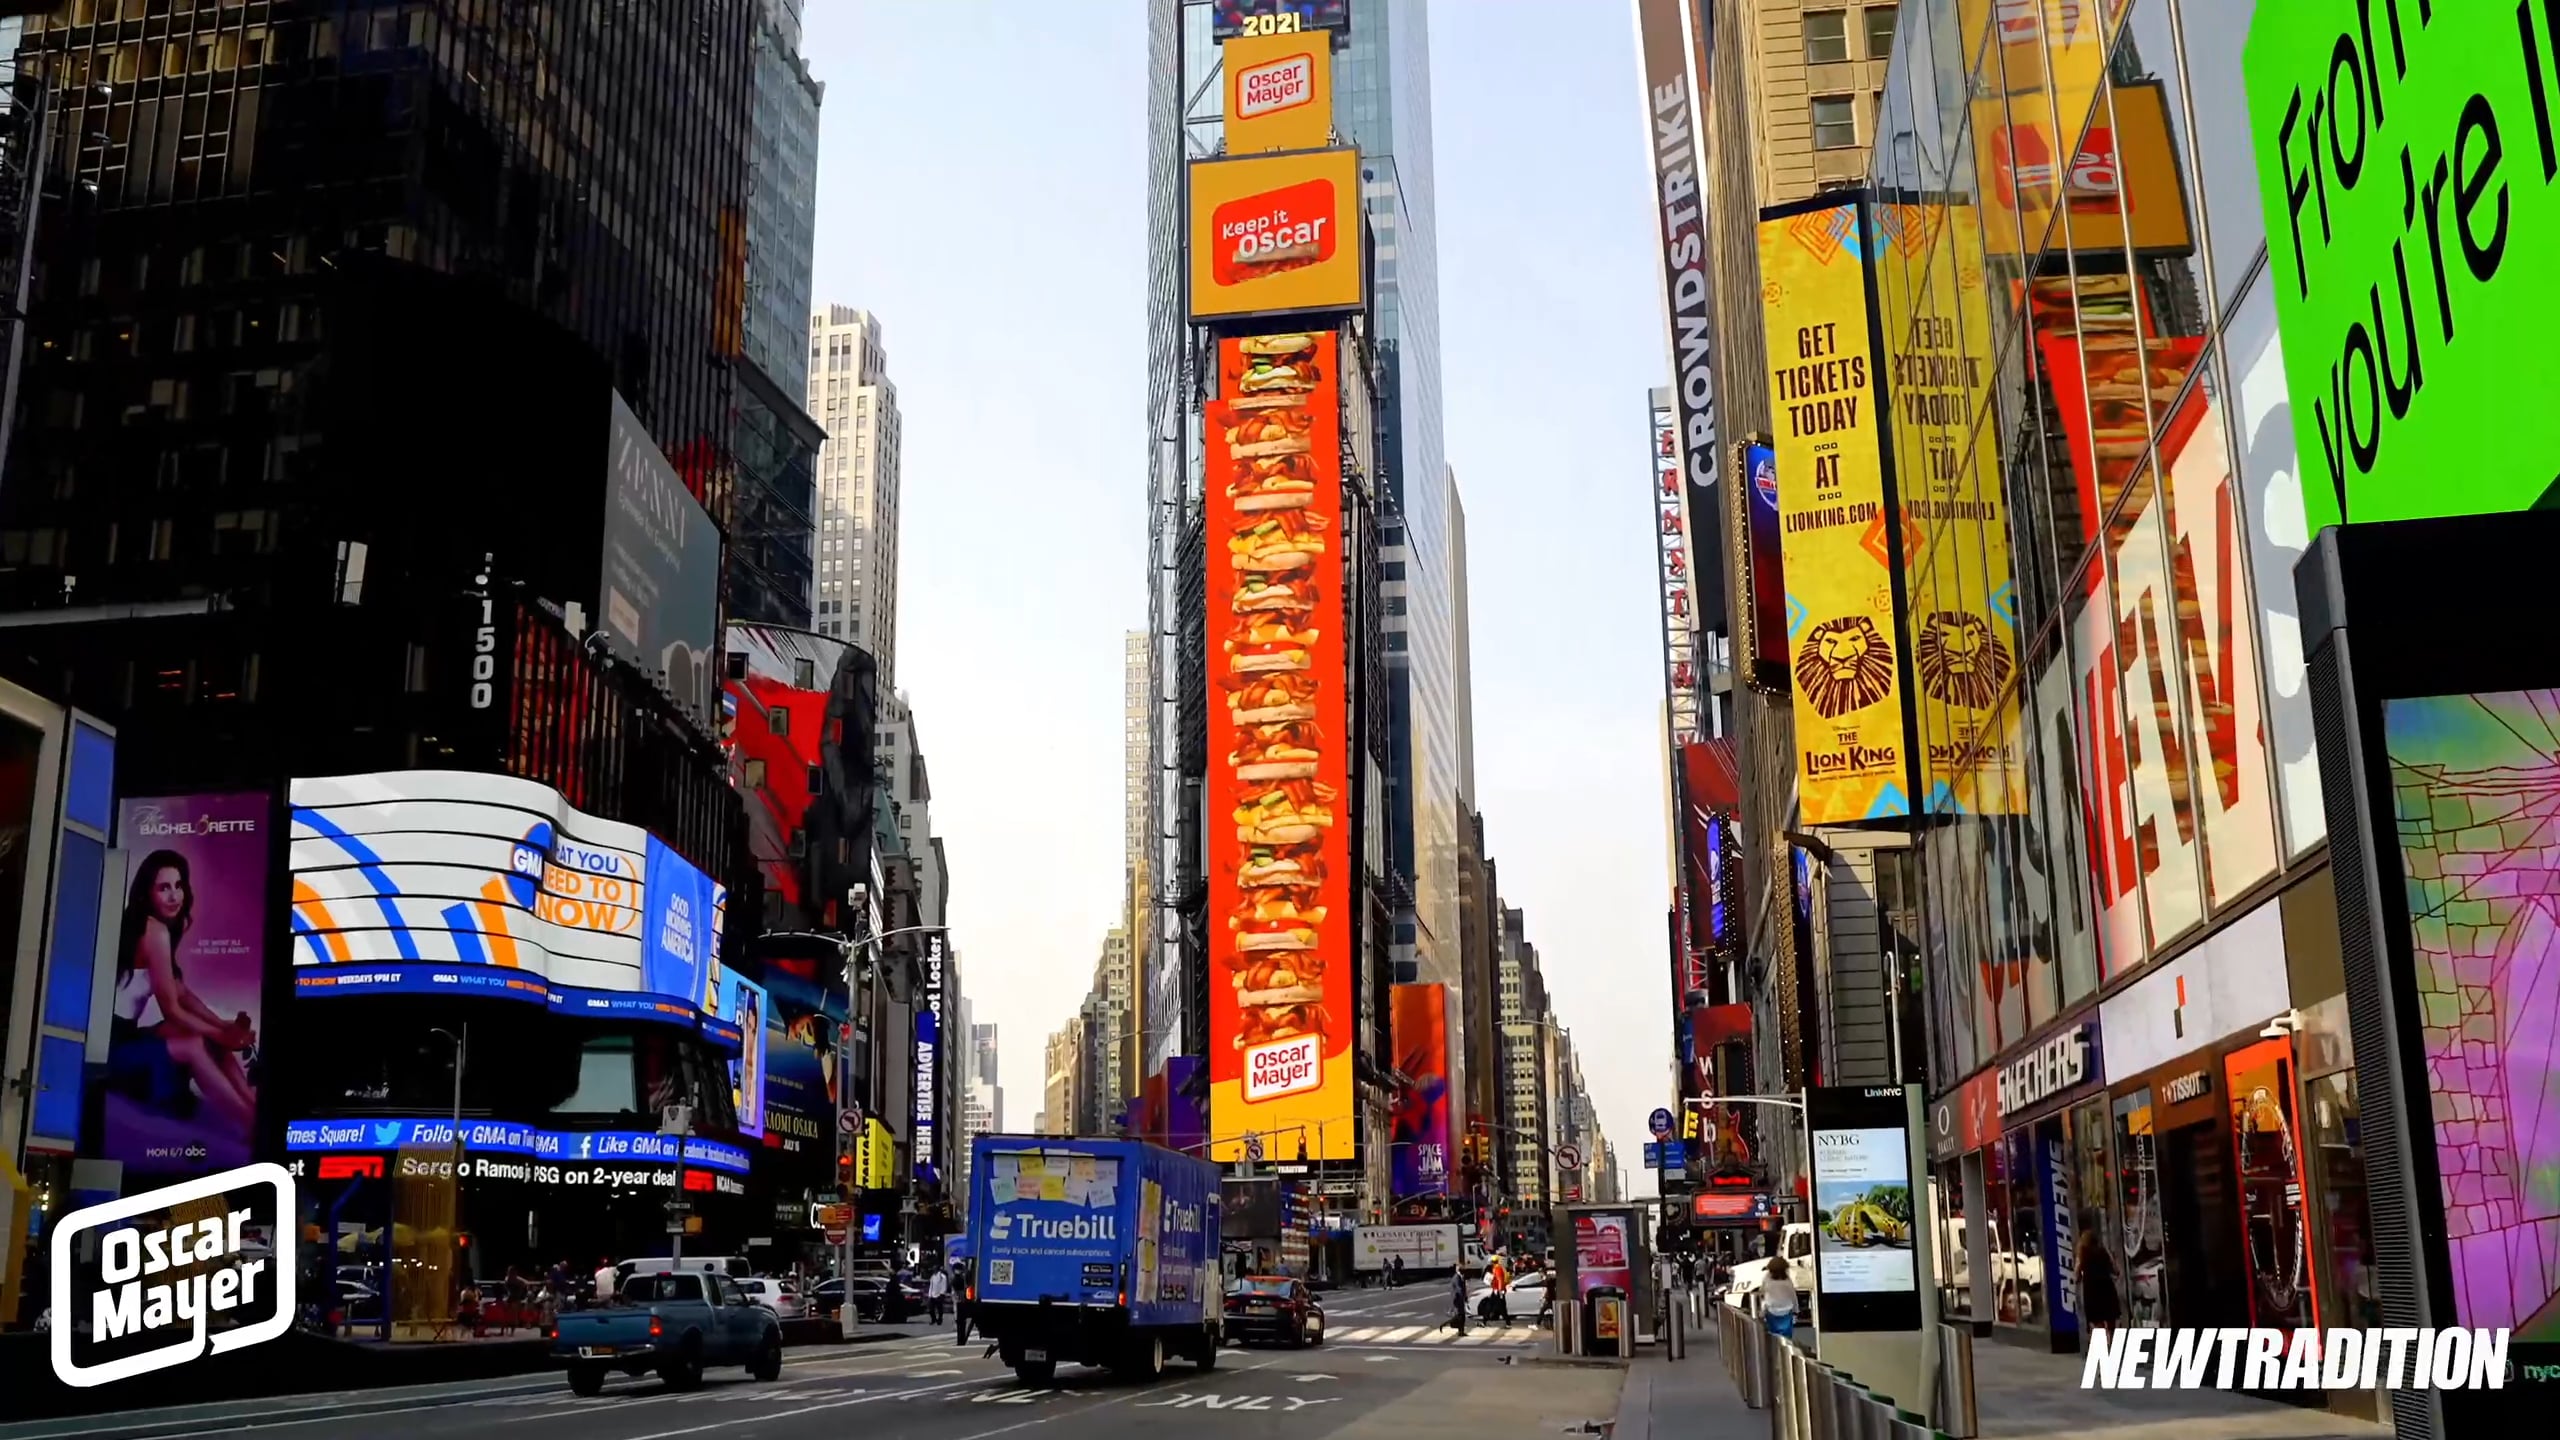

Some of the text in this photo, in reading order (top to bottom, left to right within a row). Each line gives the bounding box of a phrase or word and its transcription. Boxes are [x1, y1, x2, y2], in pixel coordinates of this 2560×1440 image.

[1242, 12, 1301, 37] 2021
[1248, 63, 1302, 91] Oscar
[1246, 78, 1304, 107] Mayer
[1222, 209, 1290, 241] Keep it
[1653, 73, 1718, 488] CROWDSTRIKE
[2314, 92, 2509, 525] you're
[1797, 322, 1837, 360] GET
[1775, 356, 1867, 401] TICKETS
[1788, 395, 1859, 438] TODAY
[1815, 453, 1841, 490] AT
[1785, 502, 1878, 534] LIONKING.COM
[470, 599, 496, 709] 1500
[1836, 731, 1858, 744] THE
[1805, 744, 1896, 776] LION KING
[139, 815, 256, 836] BACHELORETTE
[577, 850, 619, 874] YOU
[589, 876, 622, 902] TO
[670, 891, 690, 919] GOOD
[664, 906, 693, 941] MORNING
[660, 927, 695, 967] AMERICA
[926, 936, 943, 990] Locker
[459, 976, 487, 986] WHAT
[488, 977, 506, 988] YOU
[611, 1000, 636, 1009] WHAT
[638, 1001, 656, 1011] YOU
[1254, 1044, 1311, 1070] Oscar
[1996, 1023, 2084, 1119] SKECHERS
[1252, 1061, 1313, 1089] Mayer
[915, 1040, 934, 1165] ADVERTISE HERE
[1864, 1087, 1902, 1098] LinkNYC
[318, 1125, 365, 1147] Square!
[471, 1125, 507, 1145] GMA
[507, 1131, 522, 1145] on
[763, 1109, 819, 1140] NAOMI OSAKA
[146, 1148, 169, 1158] MON
[184, 1145, 208, 1158] abc
[597, 1136, 629, 1154] Like
[631, 1137, 662, 1156] GMA
[1417, 1143, 1443, 1156] SPACE
[1817, 1133, 1861, 1147] NYBG
[475, 1159, 524, 1181] Ramos
[533, 1165, 560, 1185] PSG
[564, 1169, 589, 1185] on
[593, 1167, 651, 1188] 2-year
[652, 1169, 677, 1187] deal
[1417, 1153, 1444, 1174] JAM
[1016, 1213, 1117, 1241] Truebill
[1172, 1199, 1201, 1233] Truebill
